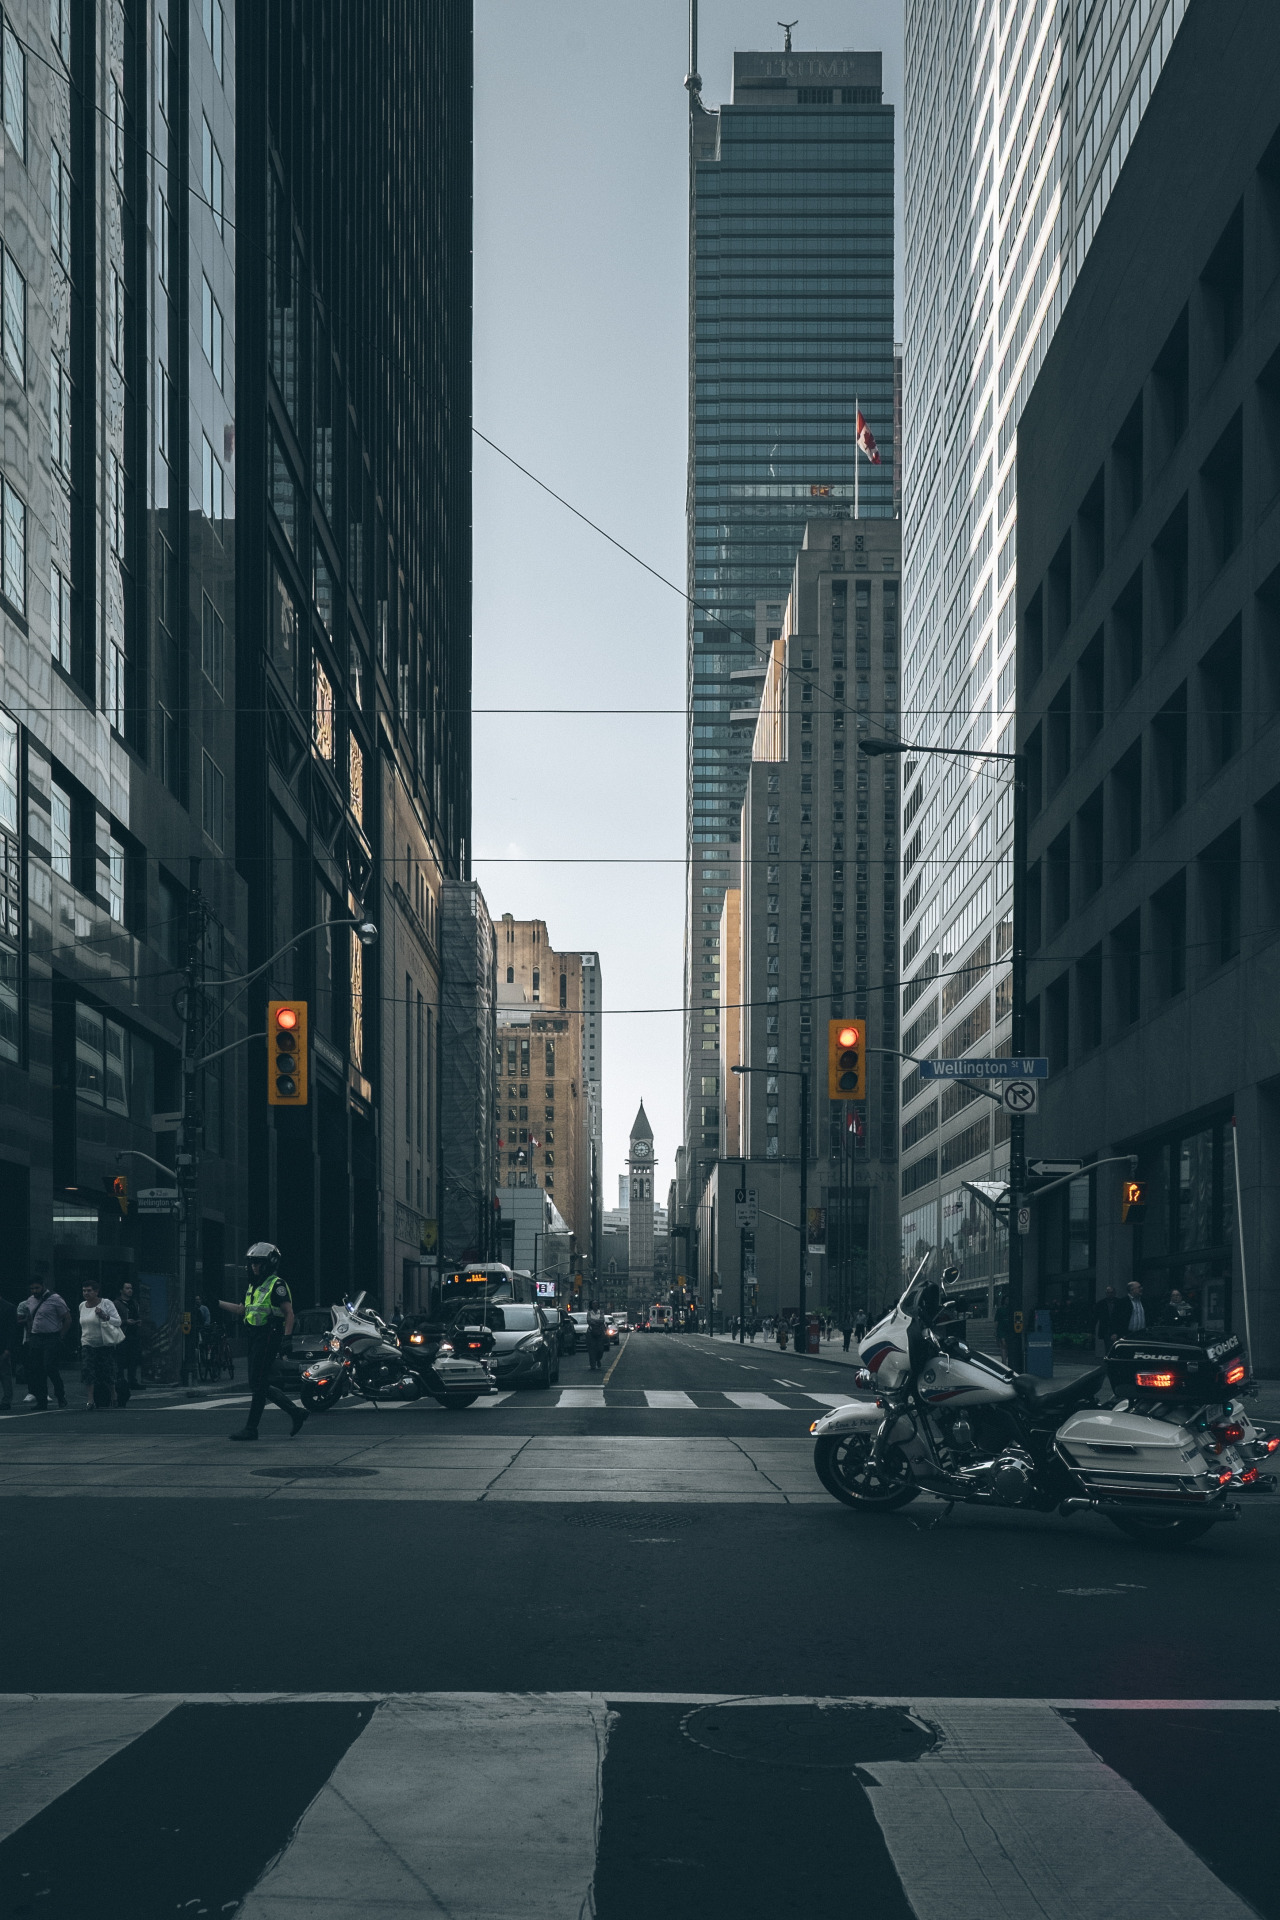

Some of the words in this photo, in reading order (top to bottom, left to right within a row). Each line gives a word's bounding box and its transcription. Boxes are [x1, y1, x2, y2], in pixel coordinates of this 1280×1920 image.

[760, 58, 855, 78] TRUMP
[933, 1060, 1007, 1077] Wellington
[1011, 1060, 1019, 1068] St
[1022, 1060, 1035, 1073] W
[137, 1198, 169, 1207] Wellington
[454, 1275, 459, 1283] 6
[1206, 1335, 1239, 1360] POLICE
